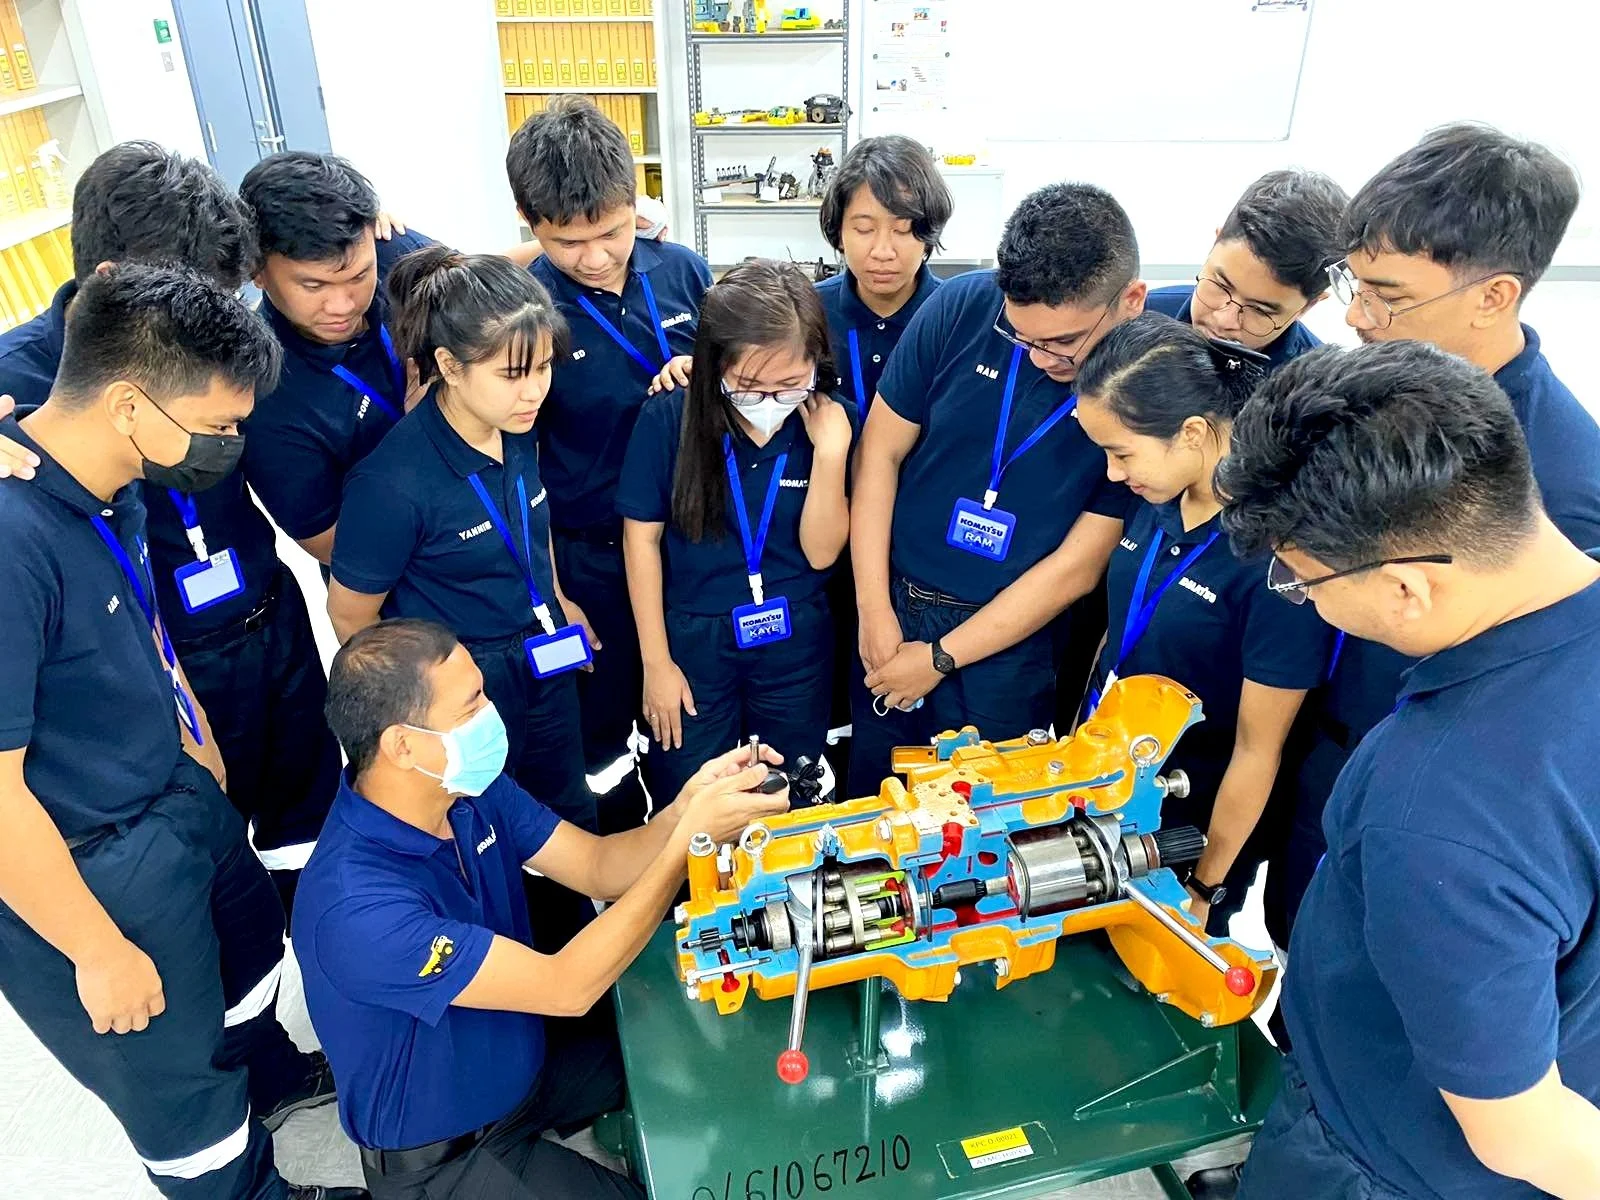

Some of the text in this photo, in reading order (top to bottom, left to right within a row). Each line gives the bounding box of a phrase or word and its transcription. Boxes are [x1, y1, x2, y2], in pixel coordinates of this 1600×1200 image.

[976, 364, 998, 380] RAM
[779, 479, 808, 488] KOMA
[960, 518, 1004, 537] KOMATSU
[965, 532, 993, 548] RAM
[742, 613, 782, 628] KOMATSU
[749, 625, 780, 638] KAYE
